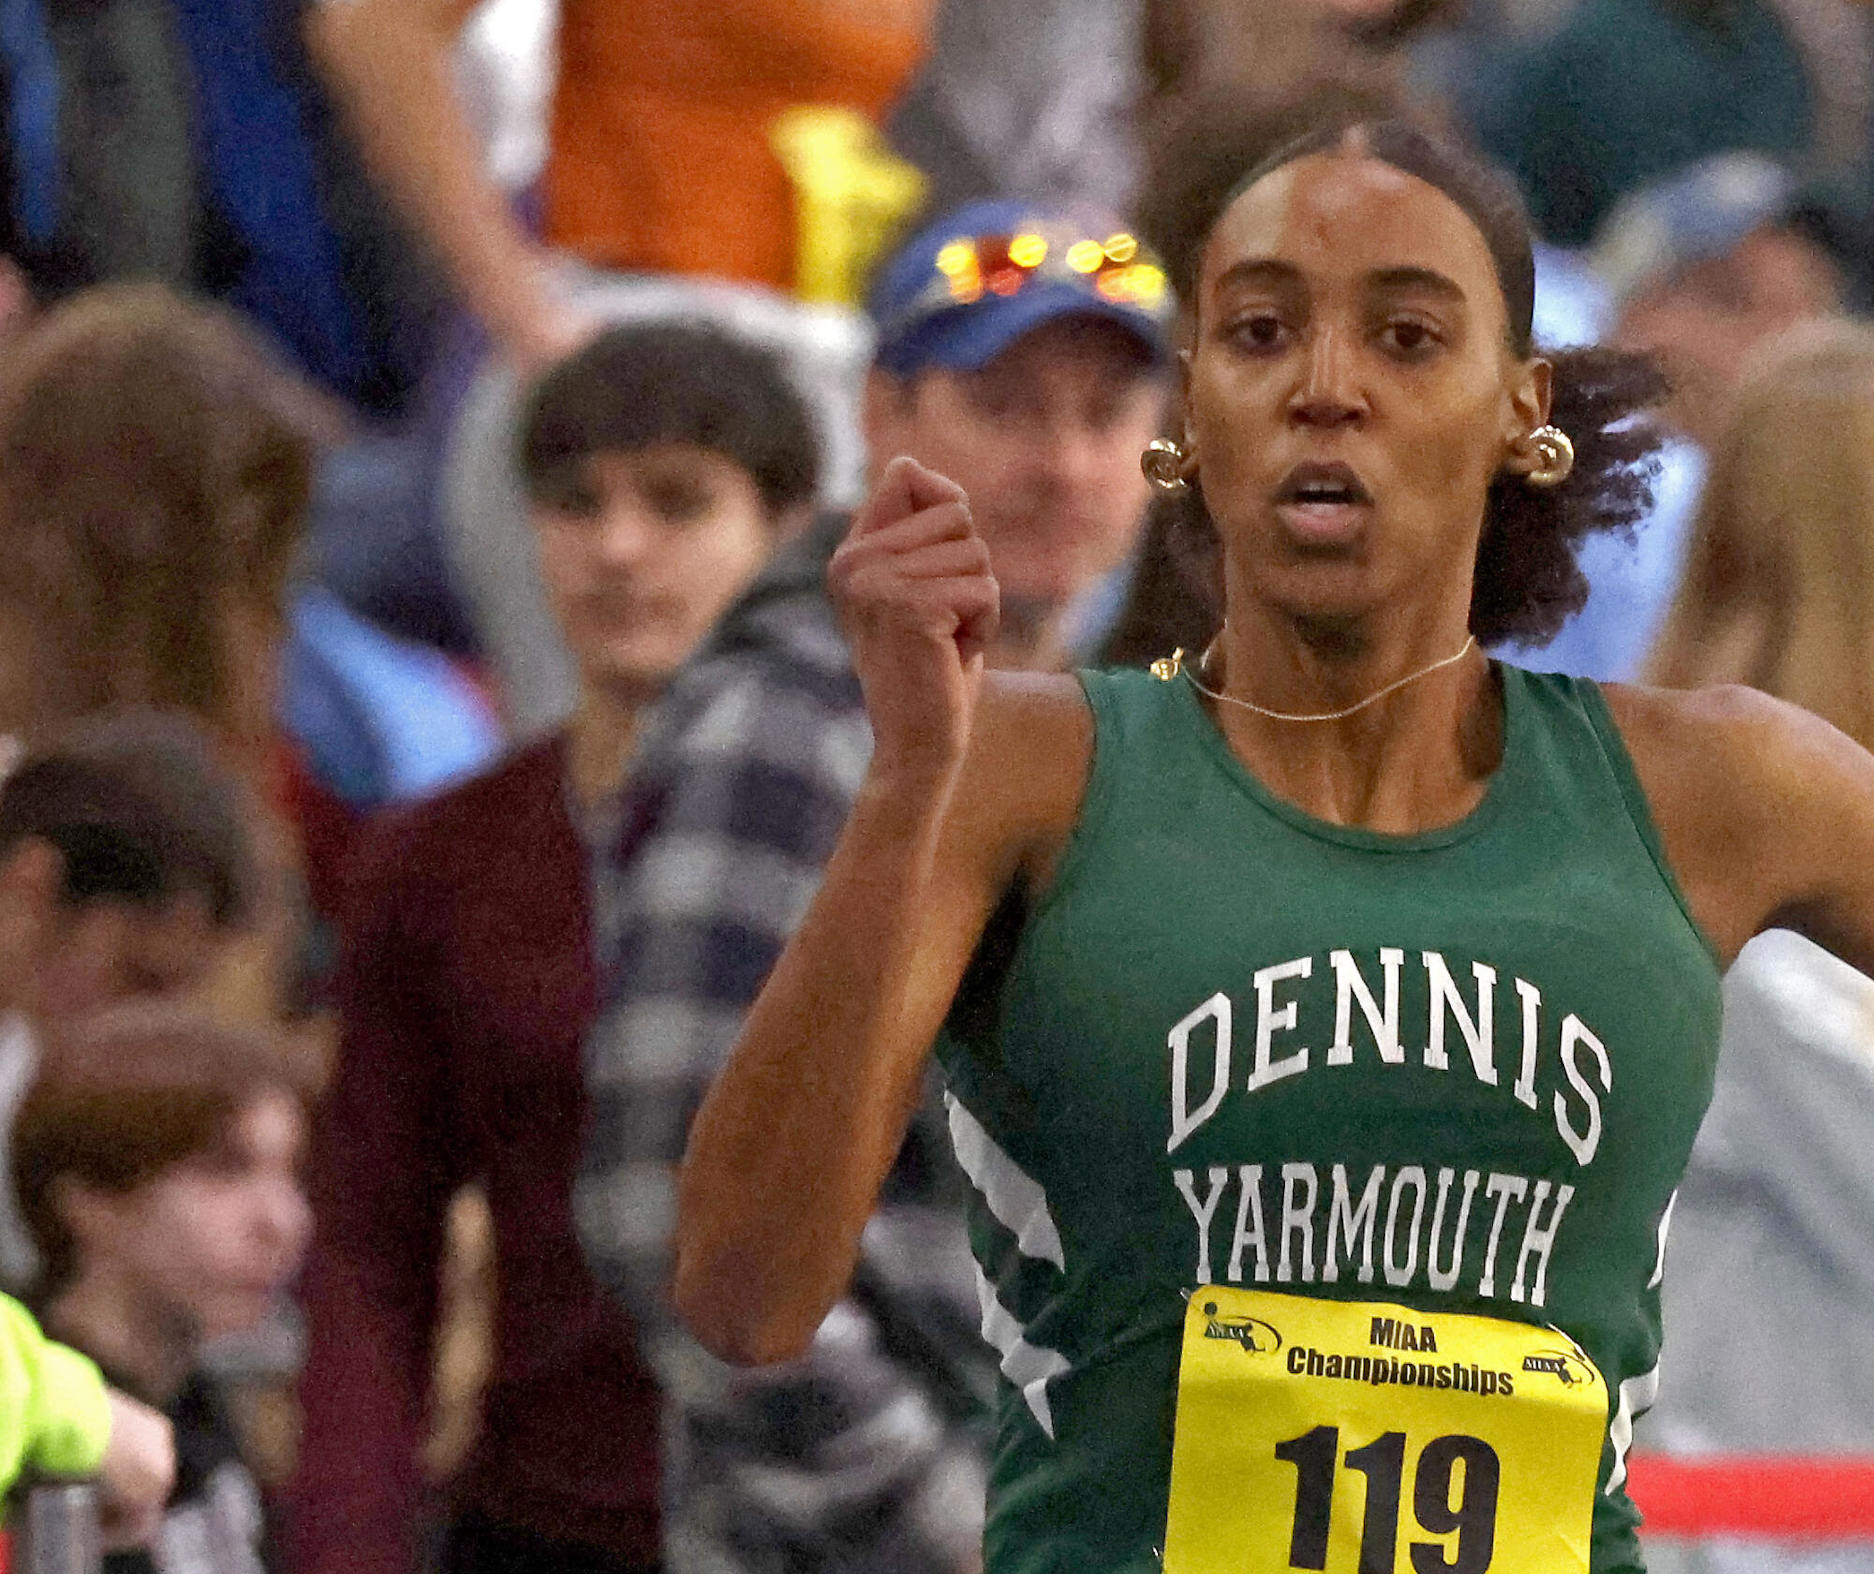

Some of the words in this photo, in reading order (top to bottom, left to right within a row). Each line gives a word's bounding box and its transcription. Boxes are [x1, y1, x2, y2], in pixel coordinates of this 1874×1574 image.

[1166, 947, 1613, 1166] DENNIS
[1173, 1161, 1576, 1307] YARMOUTH
[1286, 1345, 1514, 1397] Championships
[1369, 1316, 1438, 1353] MIAA
